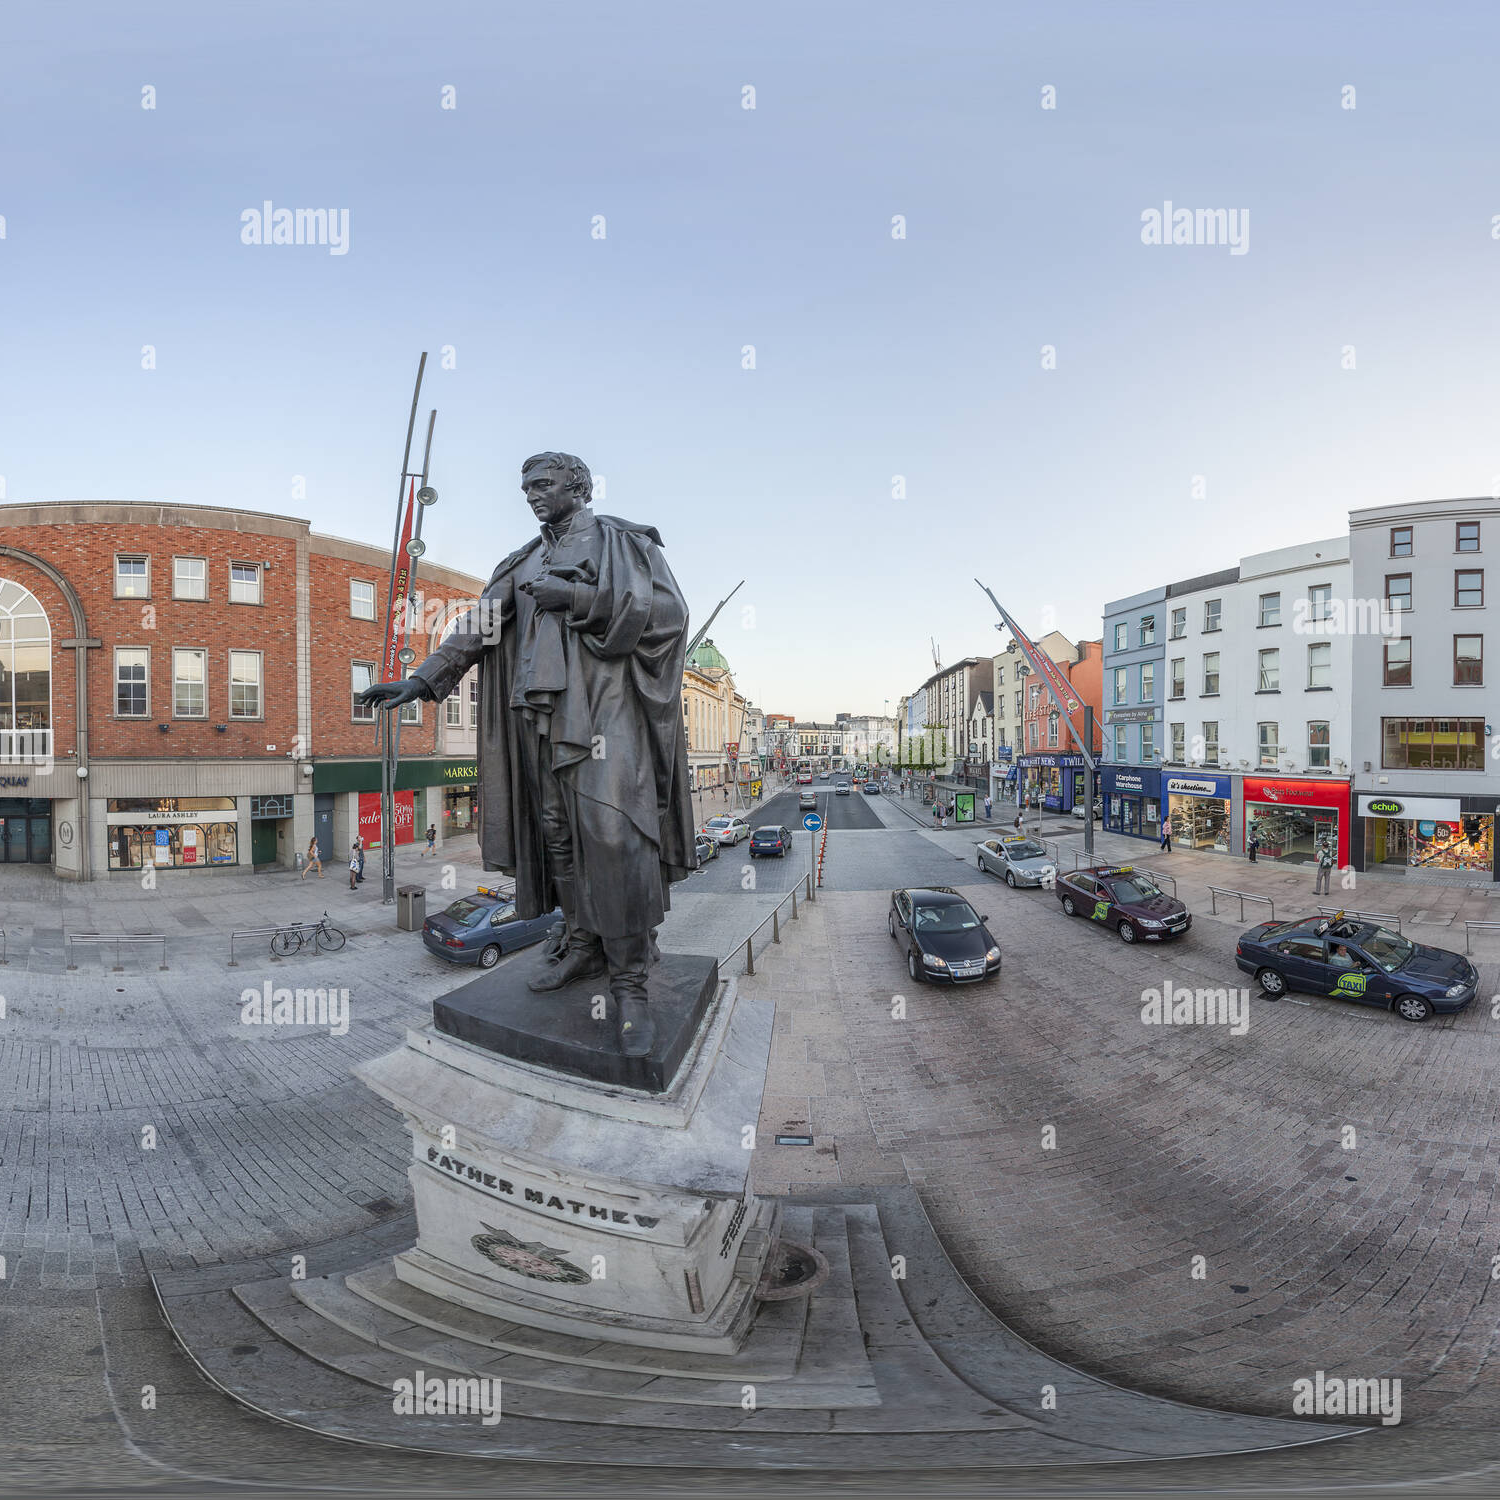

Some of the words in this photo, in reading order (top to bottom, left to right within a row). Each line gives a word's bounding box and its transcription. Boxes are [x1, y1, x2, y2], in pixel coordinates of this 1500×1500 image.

[1119, 774, 1141, 782] Carphone
[1115, 781, 1143, 790] Warehouse
[1170, 782, 1180, 790] it's
[1285, 788, 1314, 797] Footwear
[1372, 803, 1399, 812] schuh
[359, 811, 380, 825] sale
[395, 813, 412, 825] OFF
[1342, 980, 1362, 992] TAXI
[426, 1145, 515, 1196] FATHER
[524, 1187, 661, 1230] MATHEW
